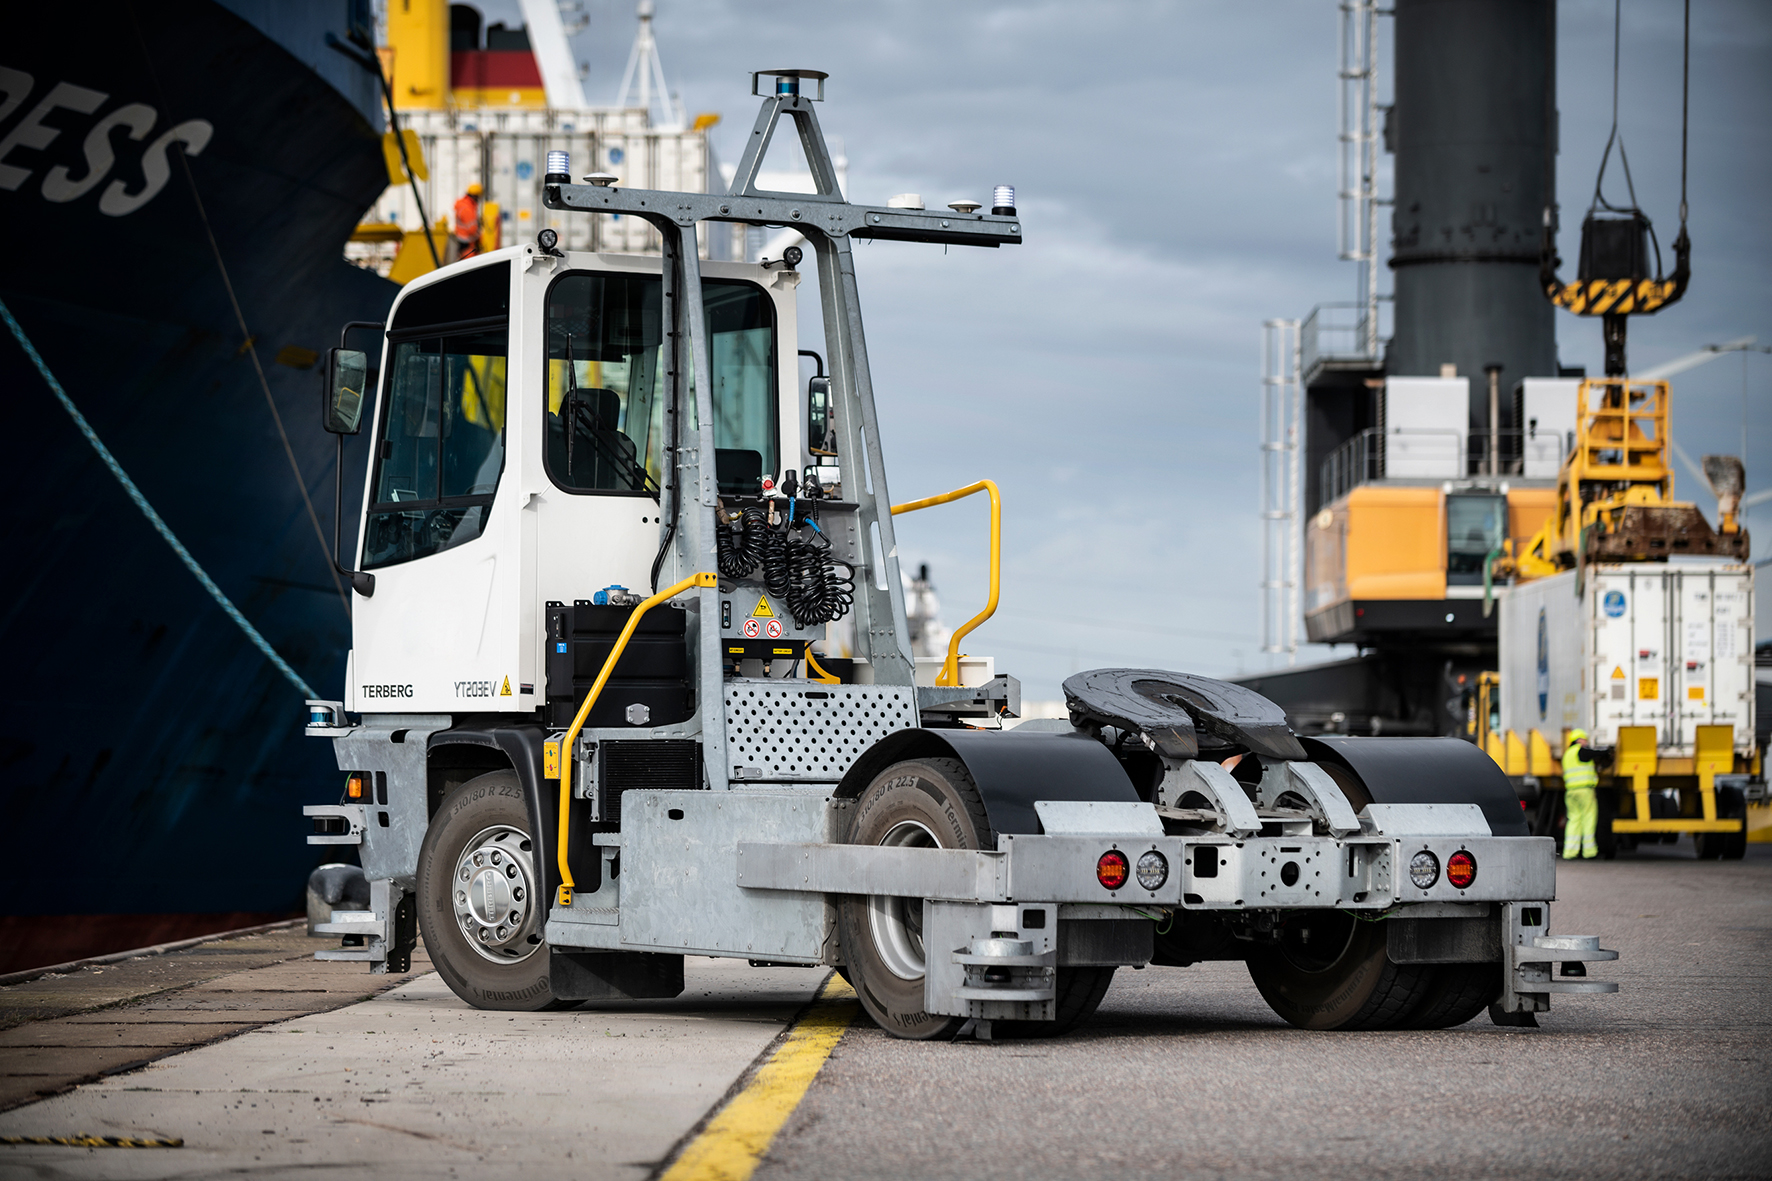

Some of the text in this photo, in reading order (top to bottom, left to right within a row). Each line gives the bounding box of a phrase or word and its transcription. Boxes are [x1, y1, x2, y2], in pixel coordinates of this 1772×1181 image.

[362, 684, 413, 698] TERBERG
[454, 681, 497, 697] YT203EV
[887, 780, 894, 791] R
[896, 776, 915, 788] 22.5
[453, 788, 485, 815] 310/80
[488, 786, 495, 796] R
[499, 786, 521, 798] 22.5
